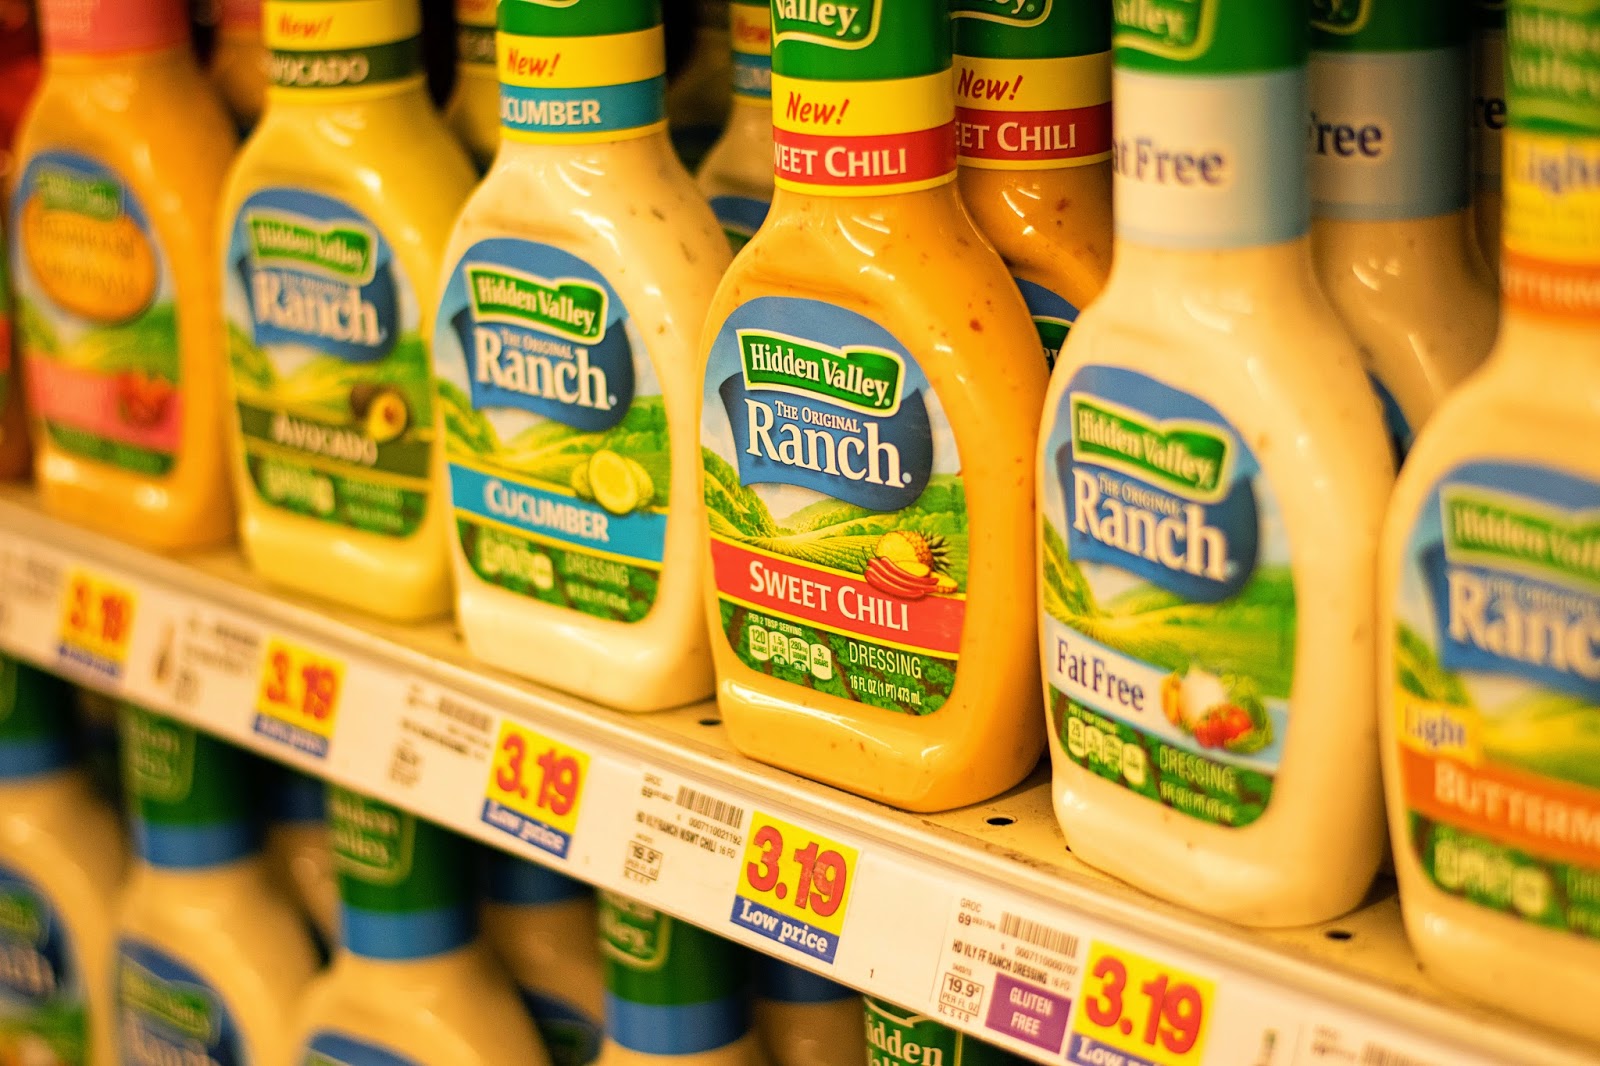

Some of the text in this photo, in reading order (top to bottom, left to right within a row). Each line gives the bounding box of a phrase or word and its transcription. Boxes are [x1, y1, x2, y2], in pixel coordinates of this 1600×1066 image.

[507, 47, 561, 77] New!
[958, 67, 1023, 101] New!
[786, 91, 850, 125] New!
[997, 121, 1076, 152] CHILI
[1310, 110, 1382, 158] ree
[824, 146, 907, 178] CHILI
[1135, 137, 1223, 186] Free
[253, 270, 382, 346] Ranch
[477, 275, 596, 334] Hidden Valley
[474, 325, 611, 410] Ranch
[750, 342, 889, 406] Hidden Valley
[774, 400, 861, 434] THE ORIGINAL
[744, 398, 906, 488] Ranch
[1078, 408, 1213, 489] Hidden Valley
[484, 479, 609, 542] CUCUMBER
[1072, 467, 1228, 583] Ranch
[749, 560, 909, 631] SWEET CHILI
[748, 612, 759, 623] PER
[779, 622, 803, 636] SERVING
[751, 628, 766, 645] 120
[849, 641, 922, 679] DRESSING
[1056, 636, 1146, 713] Fat Free
[266, 649, 337, 721] 3.19
[849, 674, 858, 690] 16
[858, 676, 867, 692] FL
[867, 678, 878, 695] OZ
[897, 686, 910, 703] 473
[496, 733, 580, 817] 3.19
[1159, 745, 1237, 794] DRESSING
[746, 825, 848, 917] 3.19
[740, 900, 829, 954] Low price
[957, 912, 972, 926] 69
[987, 951, 1012, 971] RANCH
[1012, 960, 1048, 985] DRESSING
[942, 991, 957, 1005] PER
[1009, 986, 1053, 1016] GLUTEN
[1085, 955, 1203, 1055] 3.19
[1010, 1011, 1041, 1036] FREE
